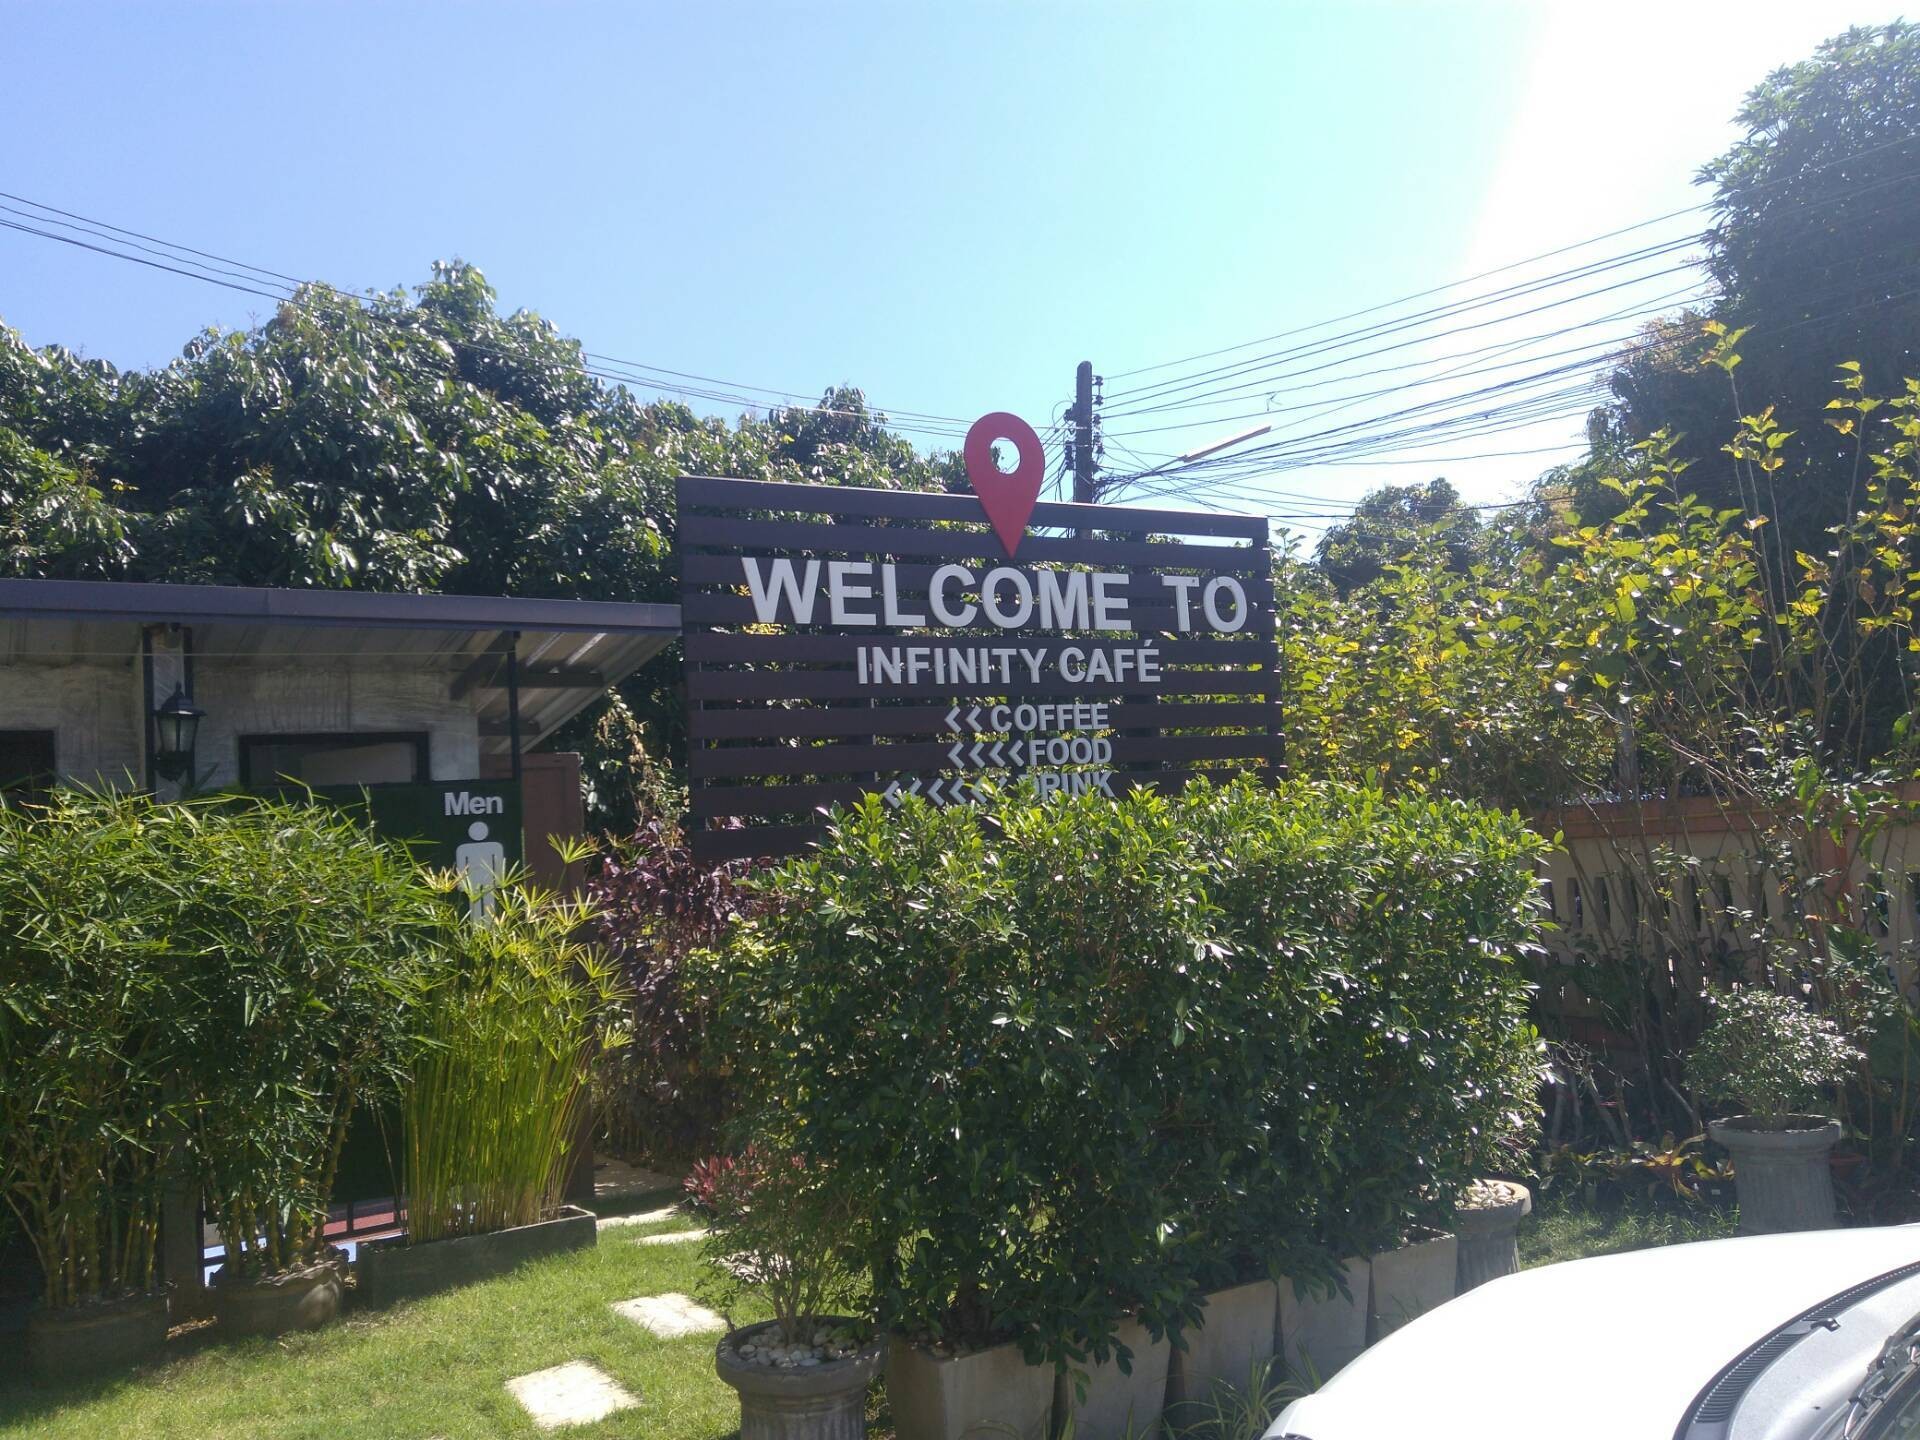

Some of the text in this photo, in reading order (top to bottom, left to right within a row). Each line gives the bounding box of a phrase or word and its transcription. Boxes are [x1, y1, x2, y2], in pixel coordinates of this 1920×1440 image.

[741, 557, 1248, 633] WELCOME TO
[857, 639, 1161, 685] INFINITY CAFÉ
[990, 703, 1110, 732] COFFEE
[1028, 737, 1113, 767] FOOD
[444, 791, 504, 816] Men
